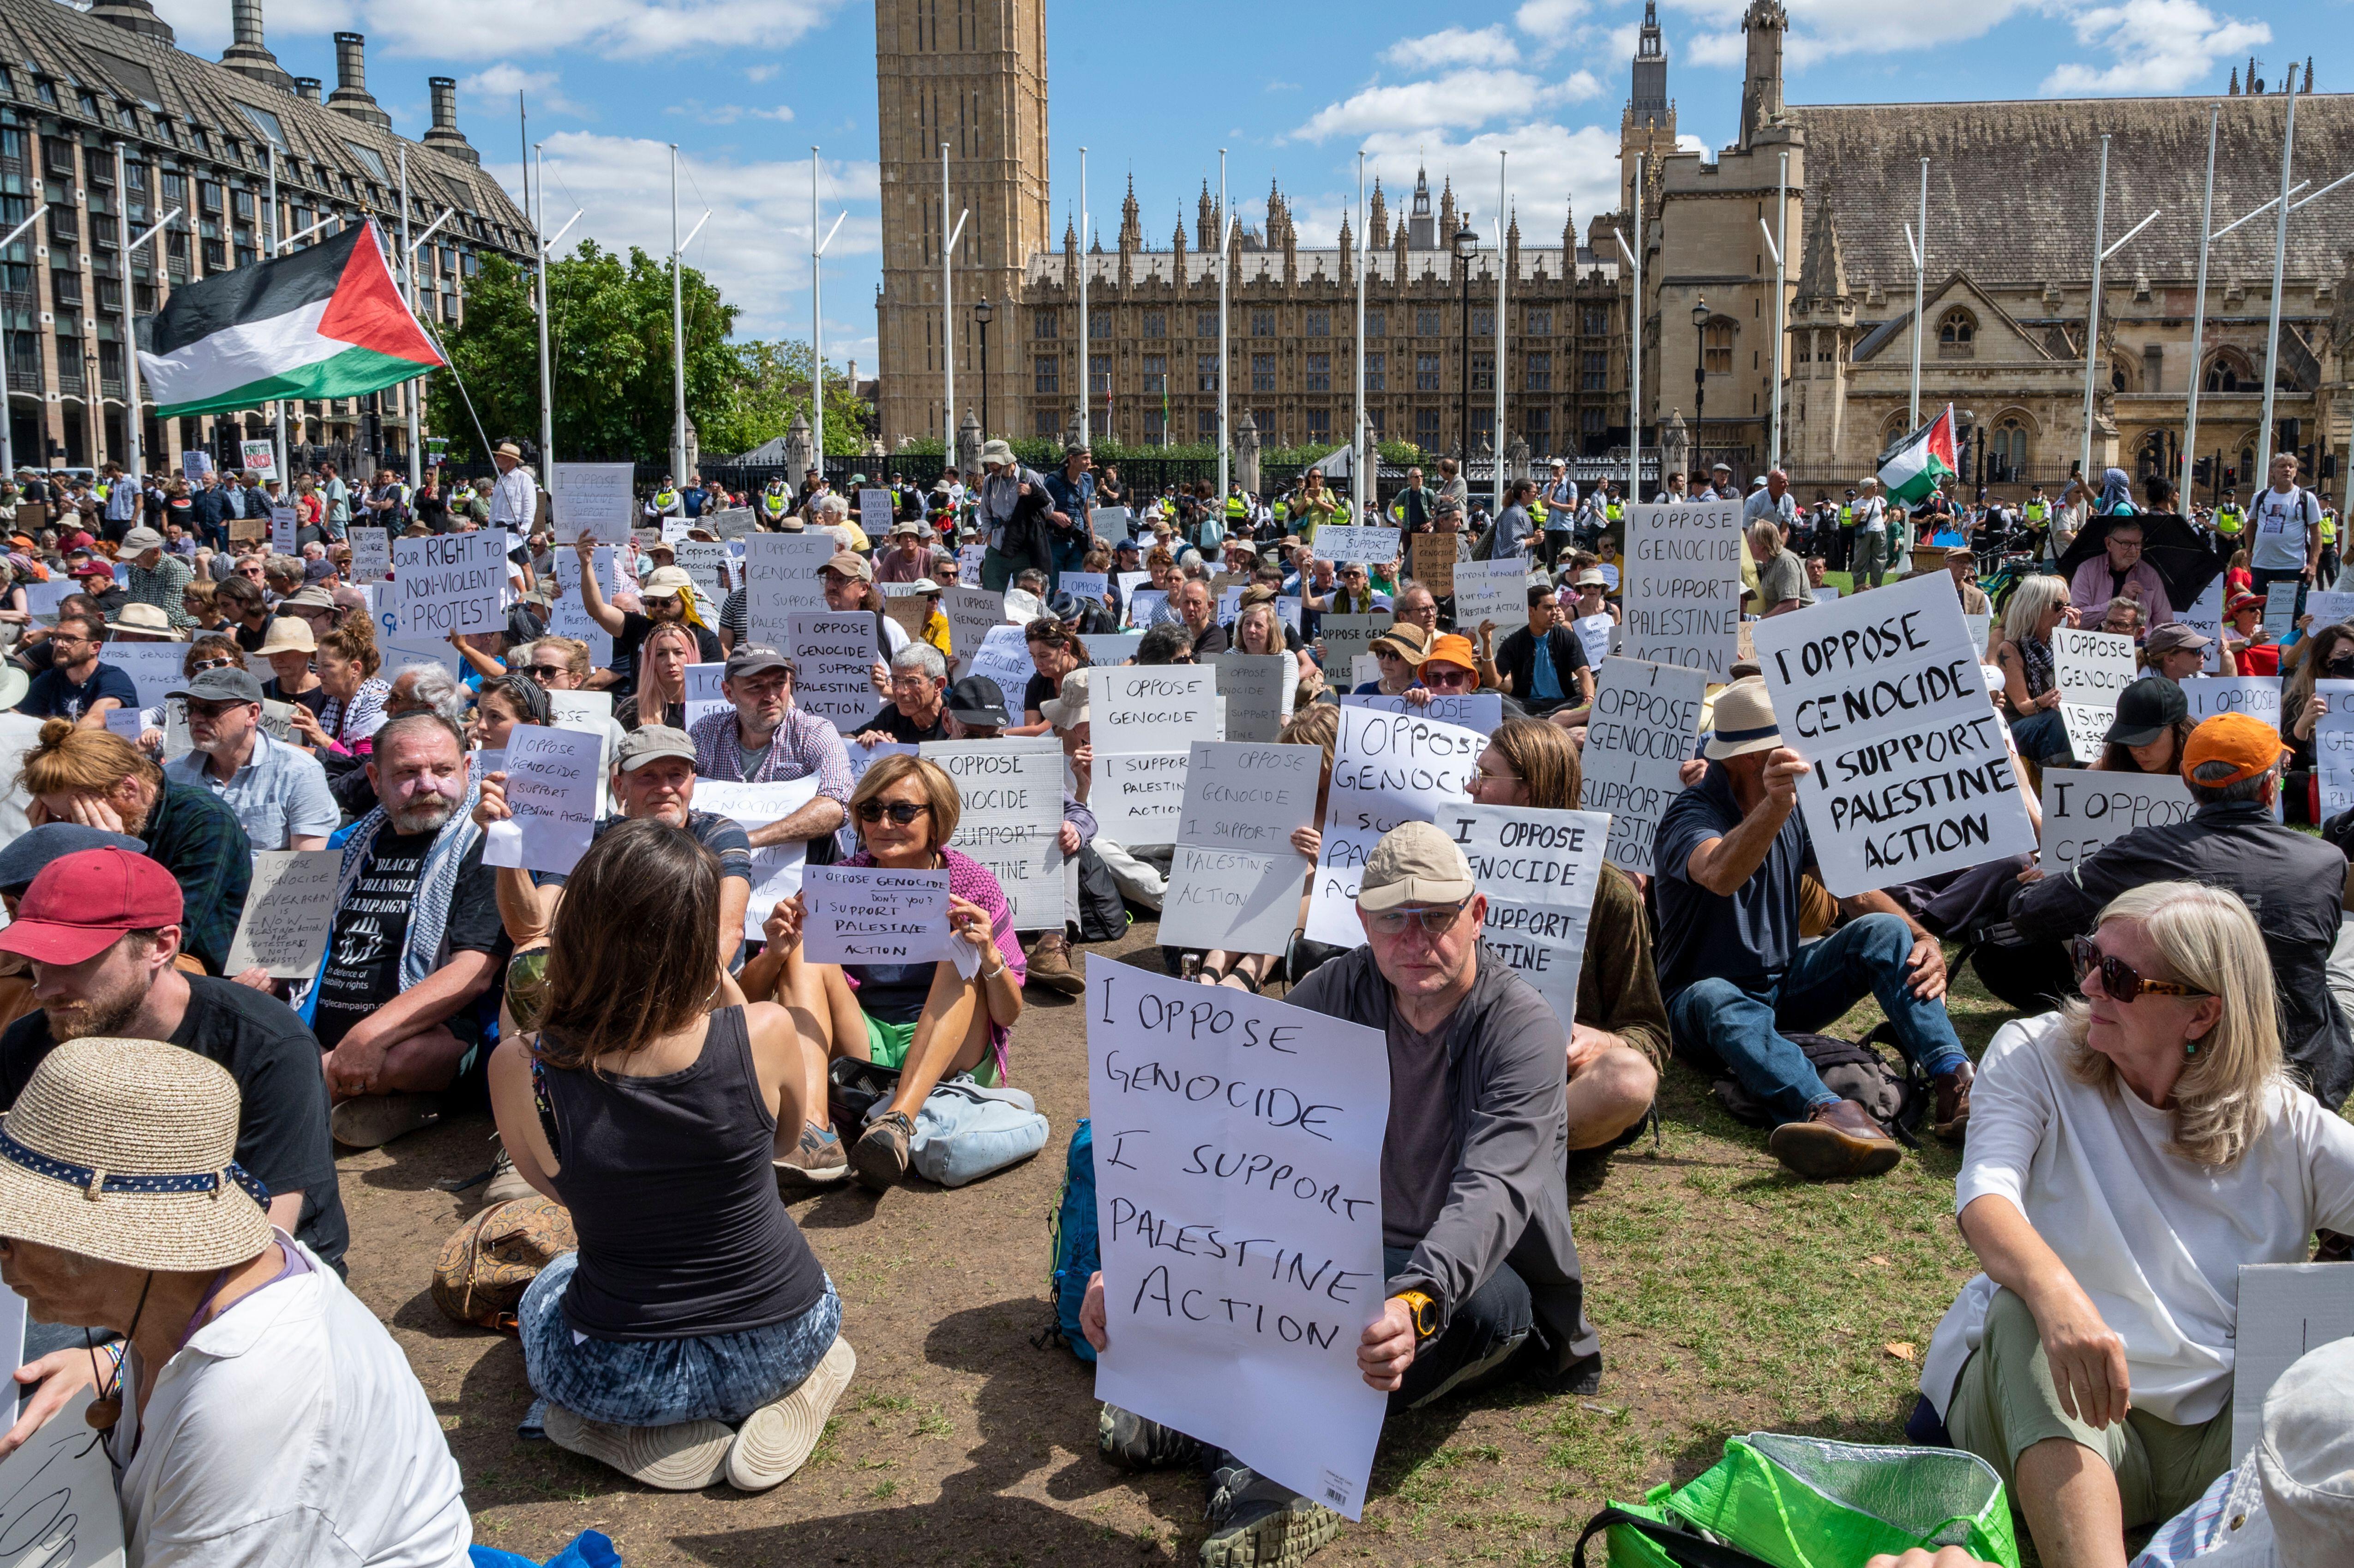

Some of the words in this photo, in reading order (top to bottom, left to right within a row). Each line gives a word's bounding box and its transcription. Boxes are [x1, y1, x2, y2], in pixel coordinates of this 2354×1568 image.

[245, 454, 272, 467] GENOCIDE
[559, 472, 565, 489] I
[575, 474, 618, 489] OPPOSE
[568, 492, 615, 504] GENOCIDE
[1632, 513, 1635, 531] I
[1652, 512, 1733, 529] OPPOSE
[354, 532, 363, 541] WE
[1325, 528, 1358, 538] OPPOSE
[396, 551, 418, 567] OUR
[426, 535, 476, 567] RIGHT
[484, 541, 502, 557] TO
[675, 544, 683, 555] I
[686, 548, 724, 559] oppose
[766, 542, 816, 555] OPPOSE
[1346, 538, 1389, 550] SUPPORT
[1638, 539, 1741, 561] GENOCIDE
[1315, 549, 1359, 560] PALESTINE
[406, 567, 498, 599] NON-VIOLENT
[1456, 571, 1486, 579] OPPOSE
[1071, 582, 1103, 593] OPPOSE
[1459, 591, 1501, 601] SUPPORT
[1629, 579, 1633, 597] I
[1642, 578, 1735, 599] SUPPORT
[773, 593, 825, 608] SUPPORT
[956, 596, 960, 608] I
[964, 598, 996, 610] OPPOSE
[1460, 605, 1492, 617] PALESTINE
[1495, 601, 1524, 612] ACTION
[414, 596, 494, 631] PROTEST
[1629, 608, 1738, 635] PALESTINE
[798, 622, 801, 633] I
[813, 623, 869, 636] OPPOSE
[797, 644, 874, 658] GENOCIDE.
[1590, 642, 1608, 650] GENOCI
[1775, 649, 1791, 685] I
[1802, 610, 1930, 677] OPPOSE
[2058, 633, 2064, 654] I
[745, 649, 765, 658] AUTRY
[819, 664, 873, 674] SUPPORT
[1650, 666, 1658, 686] I
[796, 681, 869, 692] PALESTINE
[1105, 676, 1111, 701] I
[1126, 680, 1202, 697] OPPOSE
[1796, 659, 1976, 738] GENOCIDE
[2198, 694, 2202, 714] I
[2216, 690, 2276, 712] OPPOSE
[1110, 711, 1197, 725] GENOCIDE
[1598, 688, 1698, 732] OPPOSE
[516, 734, 523, 751] I
[526, 739, 575, 756] OPPOSE
[1590, 723, 1694, 761] GENOCIDE
[1200, 750, 1215, 769] I
[1239, 752, 1305, 771] OPPOSE
[1814, 759, 1829, 790] I
[1836, 715, 1995, 782] SUPPORT
[1107, 760, 1111, 777] I
[1126, 757, 1189, 772] SUPPOR
[1630, 761, 1635, 783] I
[517, 783, 569, 798] SUPPORT
[1123, 781, 1185, 794] PALESTIN
[1203, 784, 1289, 805] GENOCIDE
[1830, 757, 2018, 833] PALESTINE
[1187, 820, 1201, 835] I
[1215, 822, 1281, 840] SUPPORT
[1453, 818, 1476, 844] I
[1500, 822, 1585, 852] OPPOSE
[1867, 812, 1990, 872] ACTION
[265, 859, 269, 870] I
[275, 859, 312, 870] OPPOSE
[375, 858, 419, 871] BLACK
[1186, 851, 1273, 874] PALESTINE
[826, 873, 870, 883] OPPOSE
[877, 877, 947, 890] GENOCIDE
[1177, 883, 1248, 905] ACTION
[343, 898, 412, 914] CAMPAIGN
[831, 901, 900, 916] SUPPORT
[244, 927, 296, 937] PALESTINE
[297, 922, 325, 932] ACTION
[845, 945, 907, 956] ACTION
[359, 970, 368, 978] of
[346, 980, 369, 990] rights
[1103, 978, 1114, 1023] I
[1140, 994, 1303, 1054] OPPOSE
[1107, 1051, 1344, 1141] GENOCIDE
[1107, 1130, 1150, 1170] I
[1183, 1145, 1375, 1221] SUPPORT
[1111, 1198, 1374, 1304] PALESTINE
[1134, 1265, 1339, 1350] ACTION
